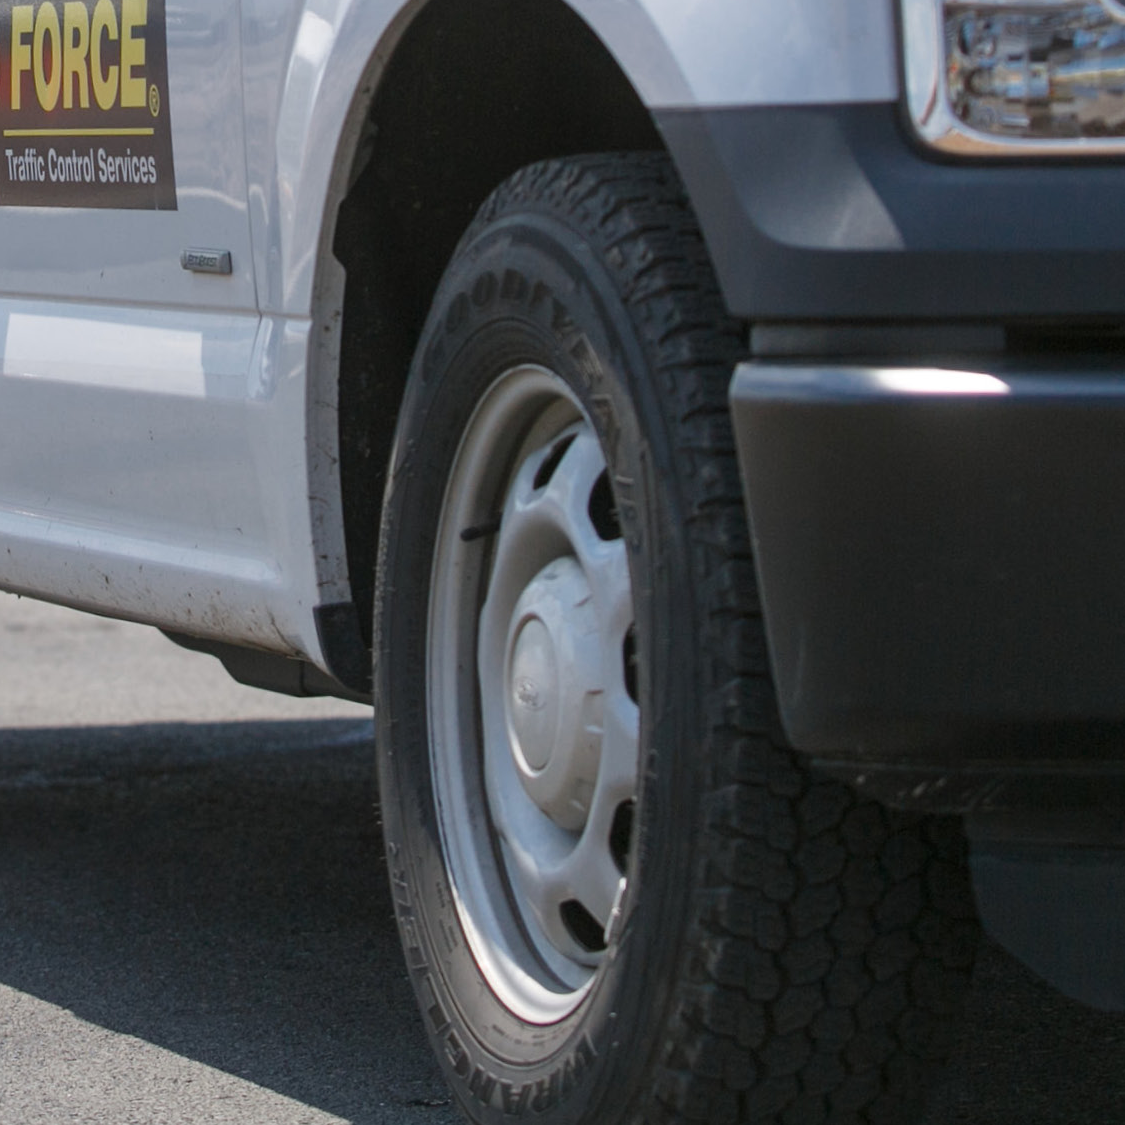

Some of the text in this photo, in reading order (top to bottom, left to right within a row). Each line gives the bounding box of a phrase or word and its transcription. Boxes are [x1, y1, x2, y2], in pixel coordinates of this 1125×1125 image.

[5, 148, 157, 183] Traffic Control Services
